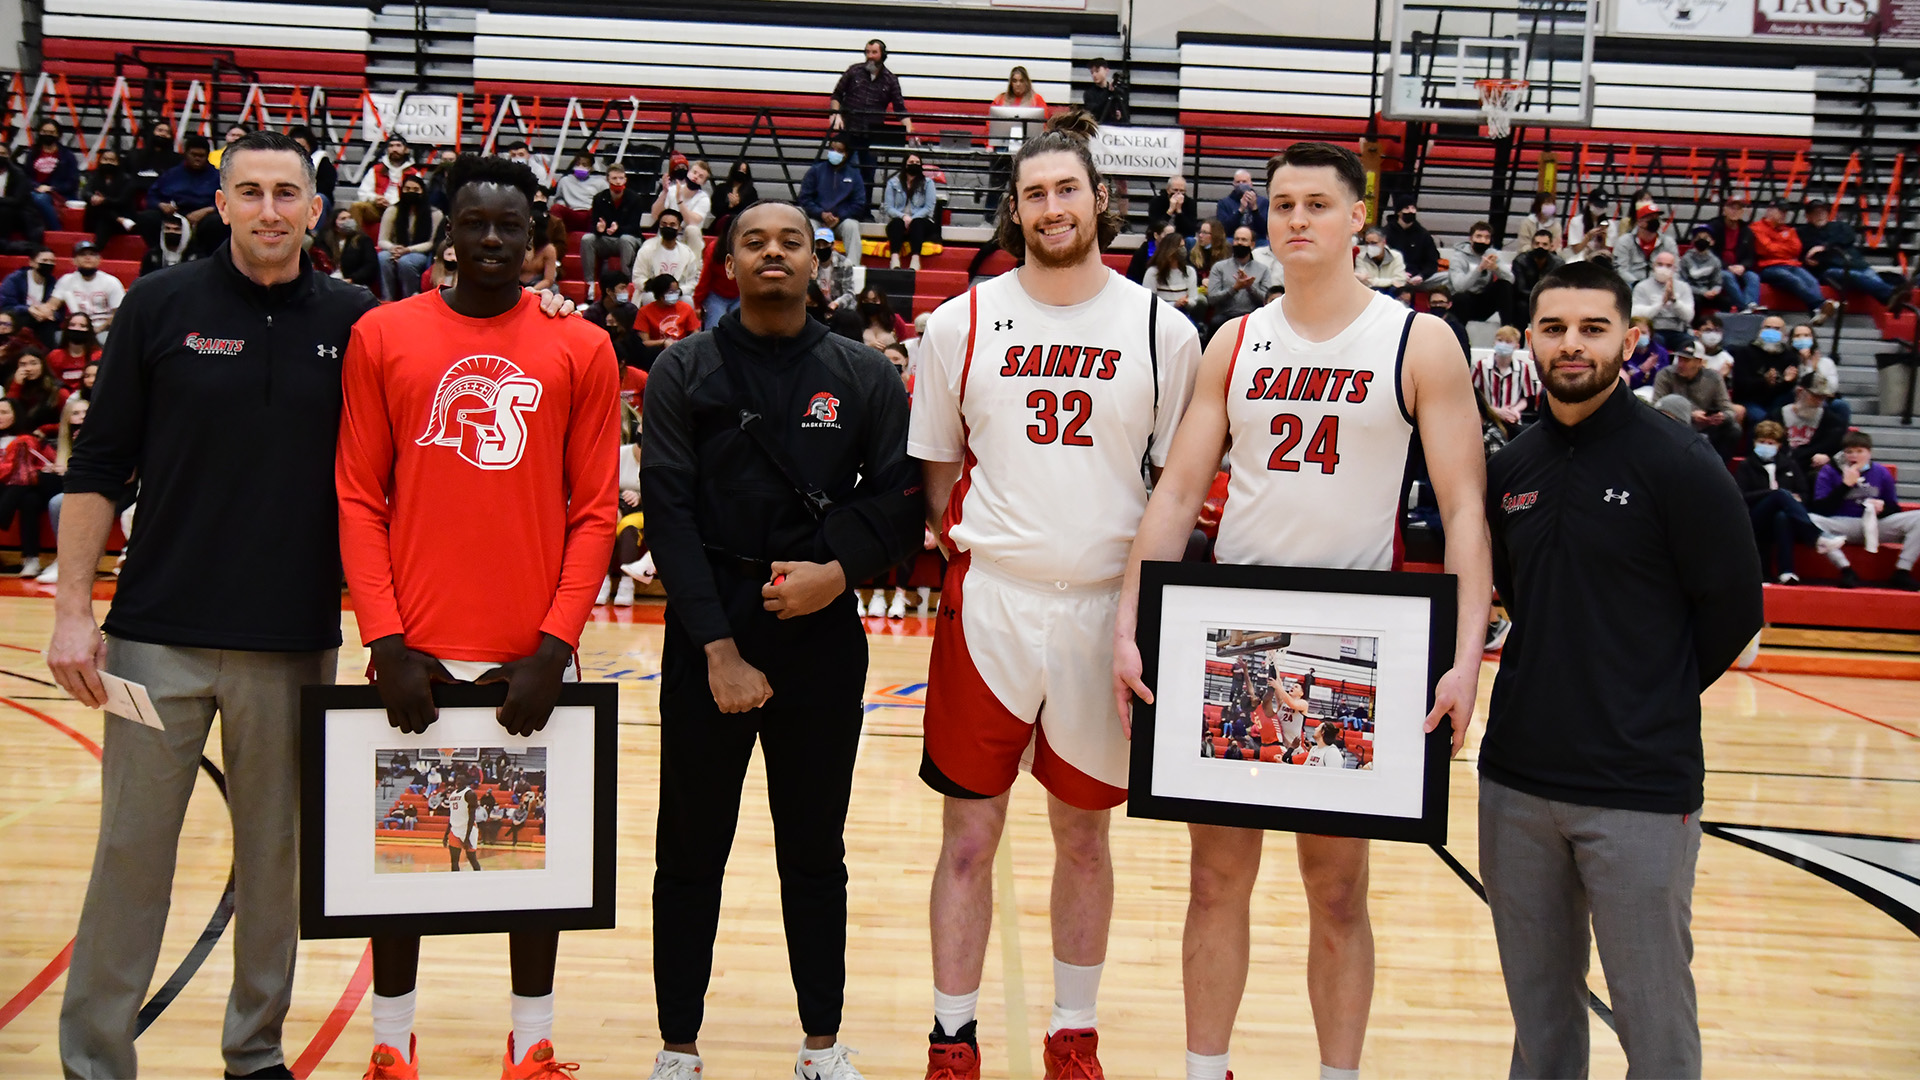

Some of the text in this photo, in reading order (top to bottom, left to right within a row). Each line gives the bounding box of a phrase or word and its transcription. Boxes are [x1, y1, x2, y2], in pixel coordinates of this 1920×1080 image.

[373, 101, 451, 117] TUDENT
[1101, 133, 1170, 149] GENERAL
[1092, 153, 1178, 168] ADMISSION
[194, 338, 245, 352] SAINTS
[1000, 344, 1121, 380] SAINTS
[1246, 367, 1374, 404] SAINTS
[1026, 389, 1094, 446] 32
[1267, 412, 1340, 475] 24
[1283, 713, 1293, 722] 24
